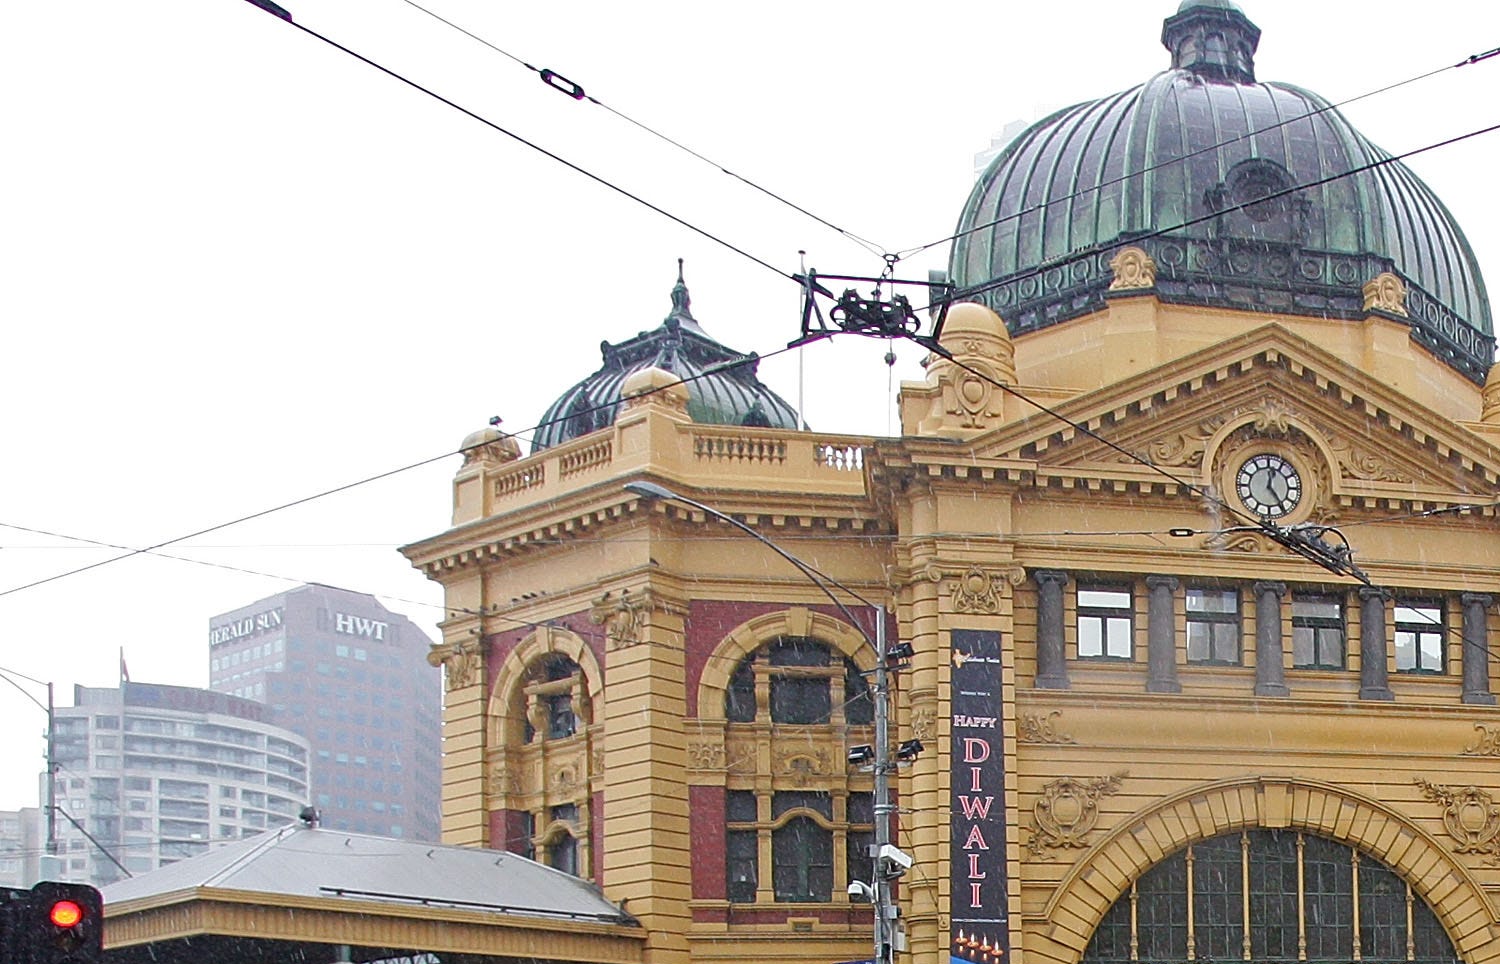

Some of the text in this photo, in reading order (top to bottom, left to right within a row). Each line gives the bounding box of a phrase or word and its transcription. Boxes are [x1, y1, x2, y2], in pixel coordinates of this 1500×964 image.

[209, 608, 285, 646] HERALD SUN
[335, 612, 389, 641] HWT
[953, 714, 997, 729] HAPPY
[958, 737, 995, 908] DIWALI
